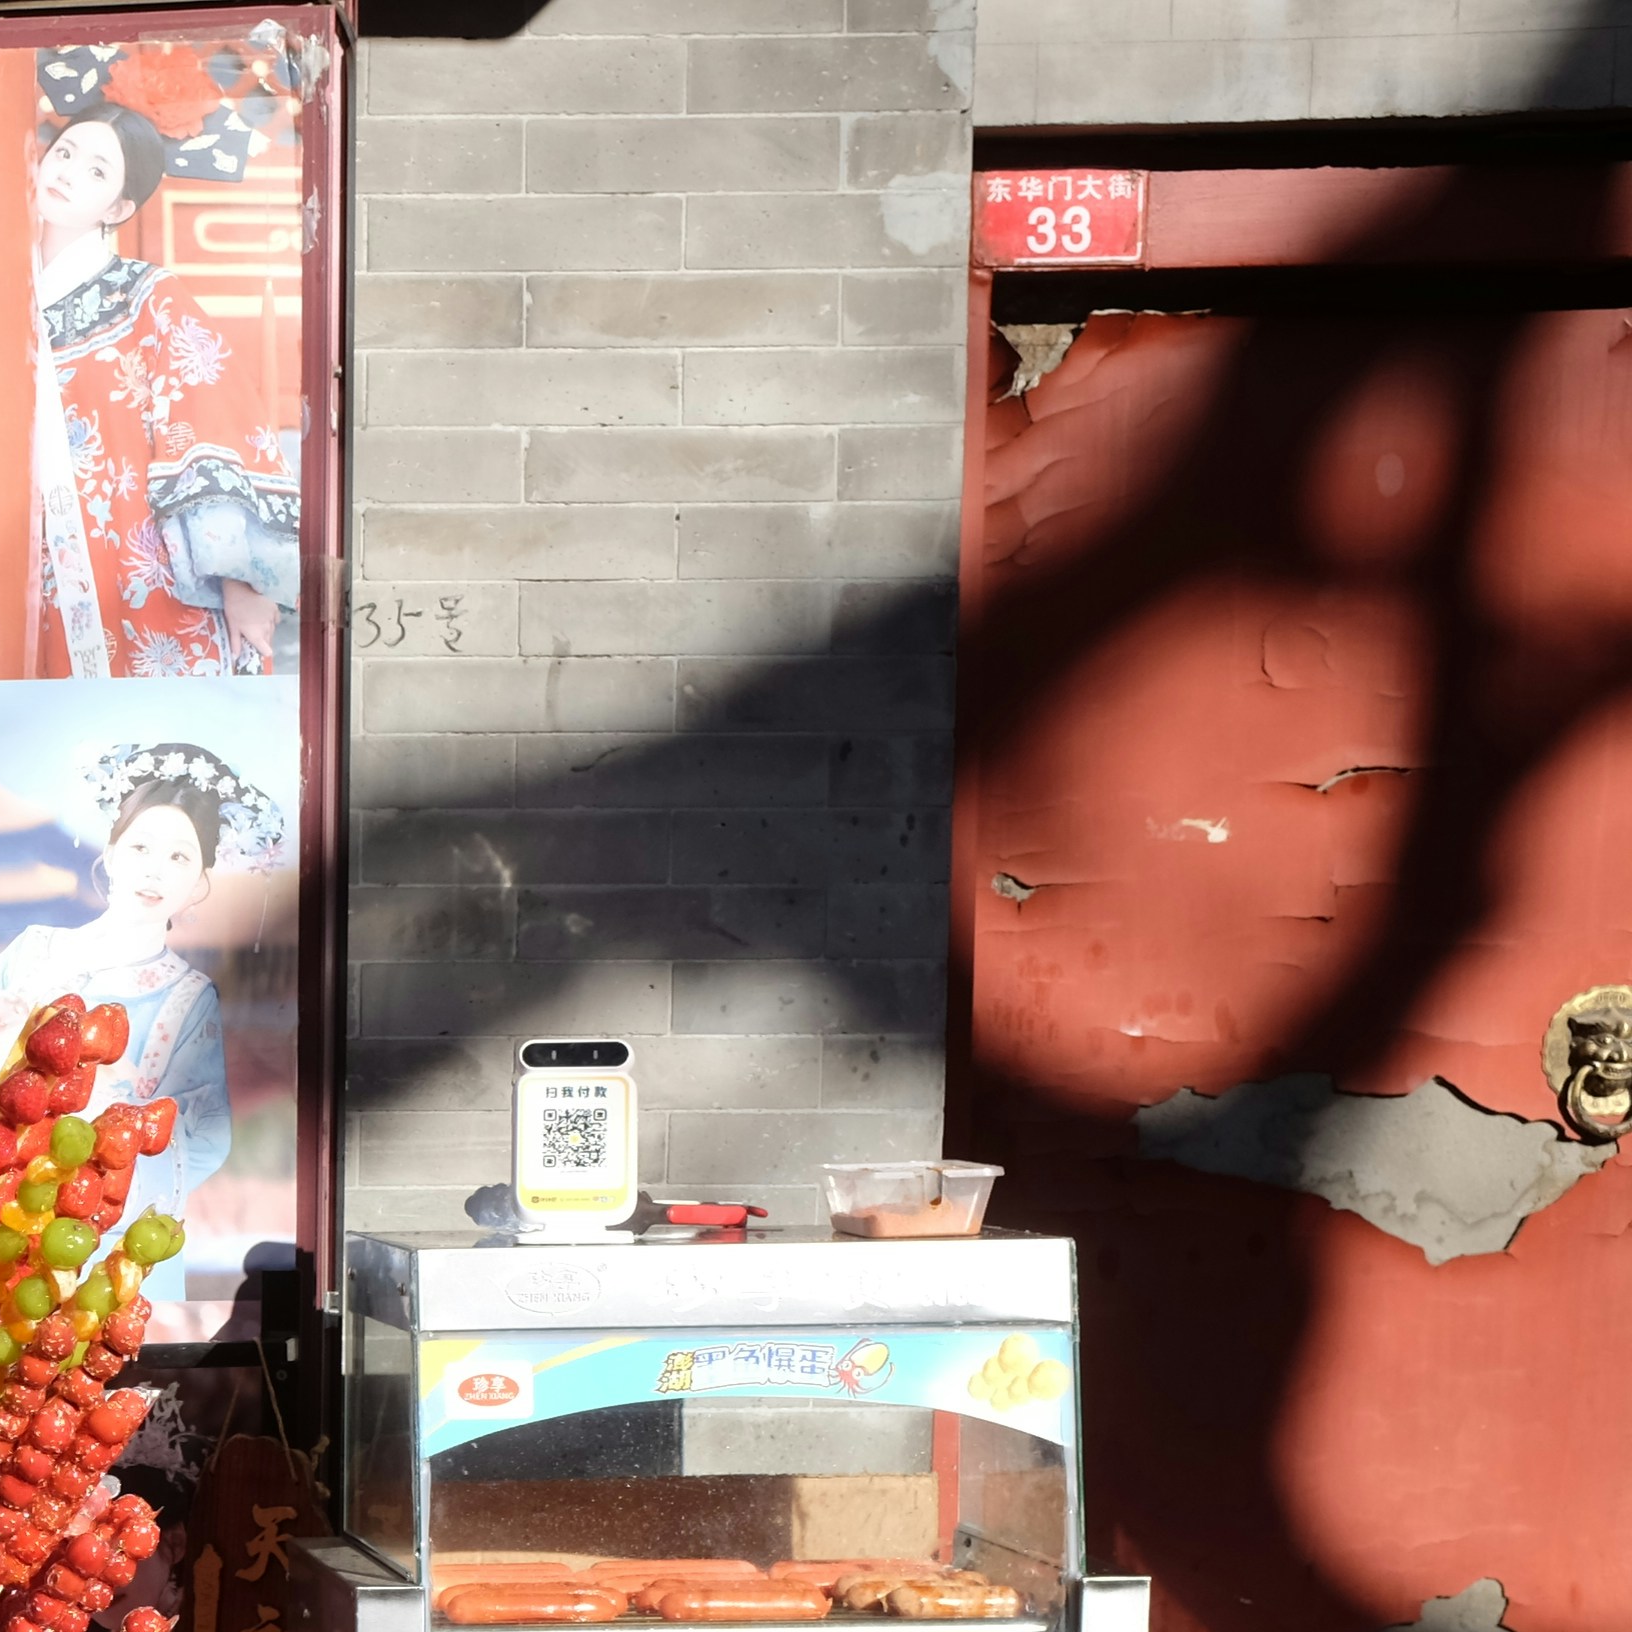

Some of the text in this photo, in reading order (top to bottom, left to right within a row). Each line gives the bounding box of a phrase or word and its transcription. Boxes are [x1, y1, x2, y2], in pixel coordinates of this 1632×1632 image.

[986, 174, 1134, 202] 东华门大街
[1026, 205, 1092, 254] 33
[545, 1086, 608, 1098] 扫我付款
[472, 1375, 507, 1393] 珍享
